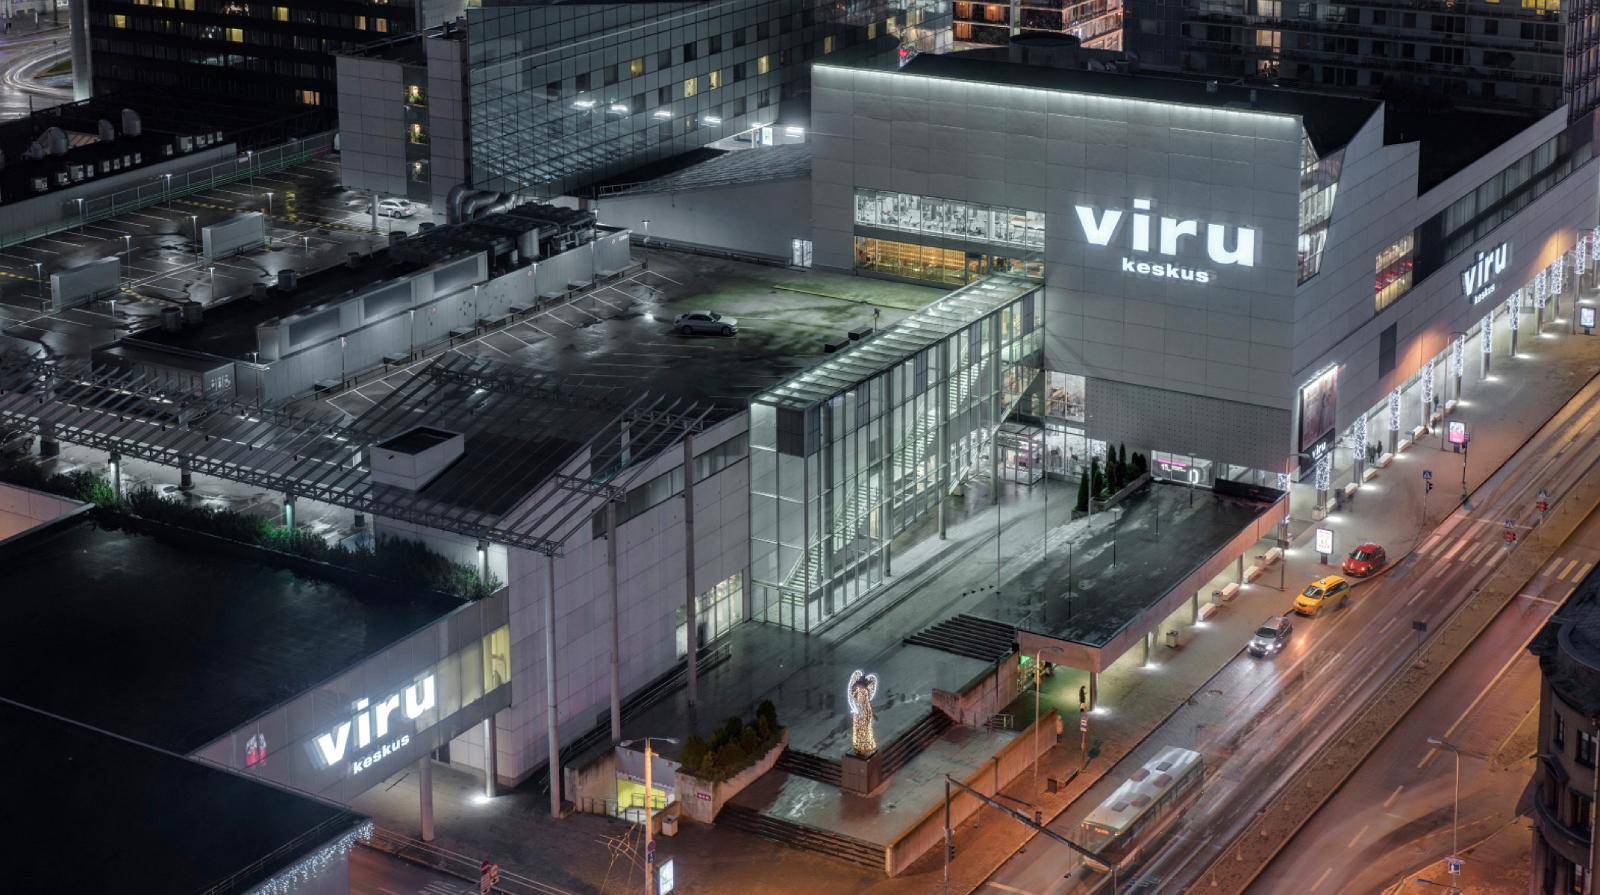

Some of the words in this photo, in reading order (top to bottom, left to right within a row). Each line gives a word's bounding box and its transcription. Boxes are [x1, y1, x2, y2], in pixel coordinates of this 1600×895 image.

[1074, 198, 1255, 267] viru
[1122, 256, 1209, 283] keskus
[1464, 243, 1507, 296] viru
[316, 674, 435, 767] viru
[352, 734, 411, 775] keskus
